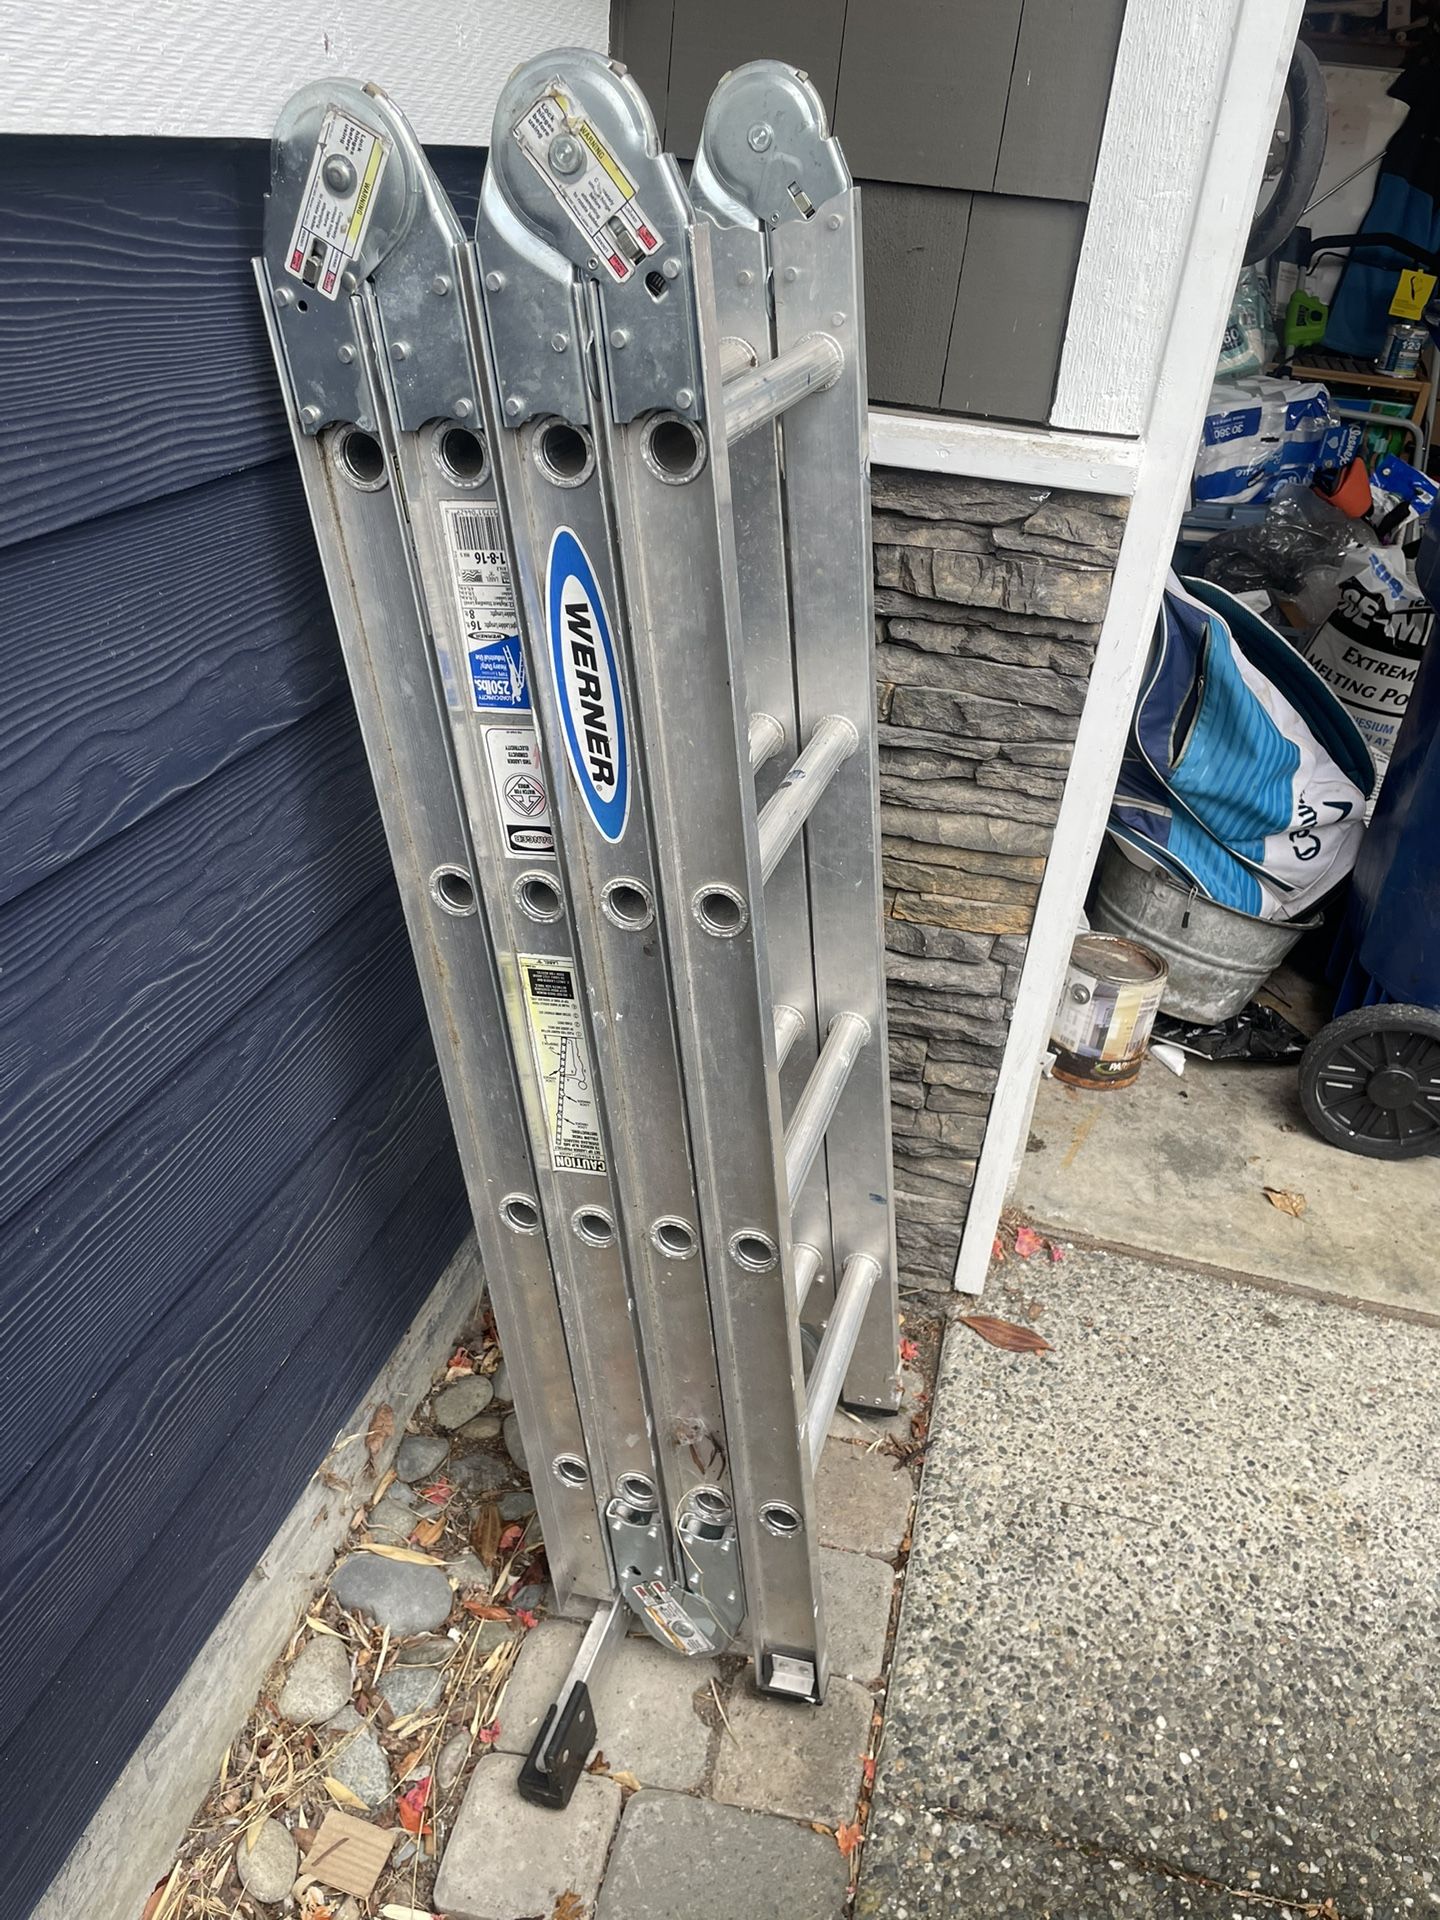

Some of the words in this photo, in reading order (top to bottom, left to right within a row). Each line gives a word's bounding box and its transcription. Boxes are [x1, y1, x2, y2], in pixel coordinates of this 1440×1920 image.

[535, 107, 554, 133] hinges
[540, 102, 556, 122] Lock
[338, 123, 349, 144] using
[527, 118, 543, 139] using
[531, 112, 550, 137] before
[343, 127, 355, 151] before
[348, 130, 360, 155] hinges
[356, 134, 366, 152] Lock
[579, 124, 604, 159] WARNING
[356, 182, 370, 215] WARNING
[474, 552, 505, 564] 1-8-16
[468, 609, 475, 619] 8
[470, 620, 481, 630] 16
[1342, 646, 1417, 683] EXTREM
[1308, 653, 1377, 699] MELTING
[1379, 688, 1411, 707] PO
[565, 601, 615, 787] WERNER
[1353, 715, 1395, 736] NESIUM
[513, 835, 553, 844] DANGER
[555, 1156, 605, 1171] CAUTION
